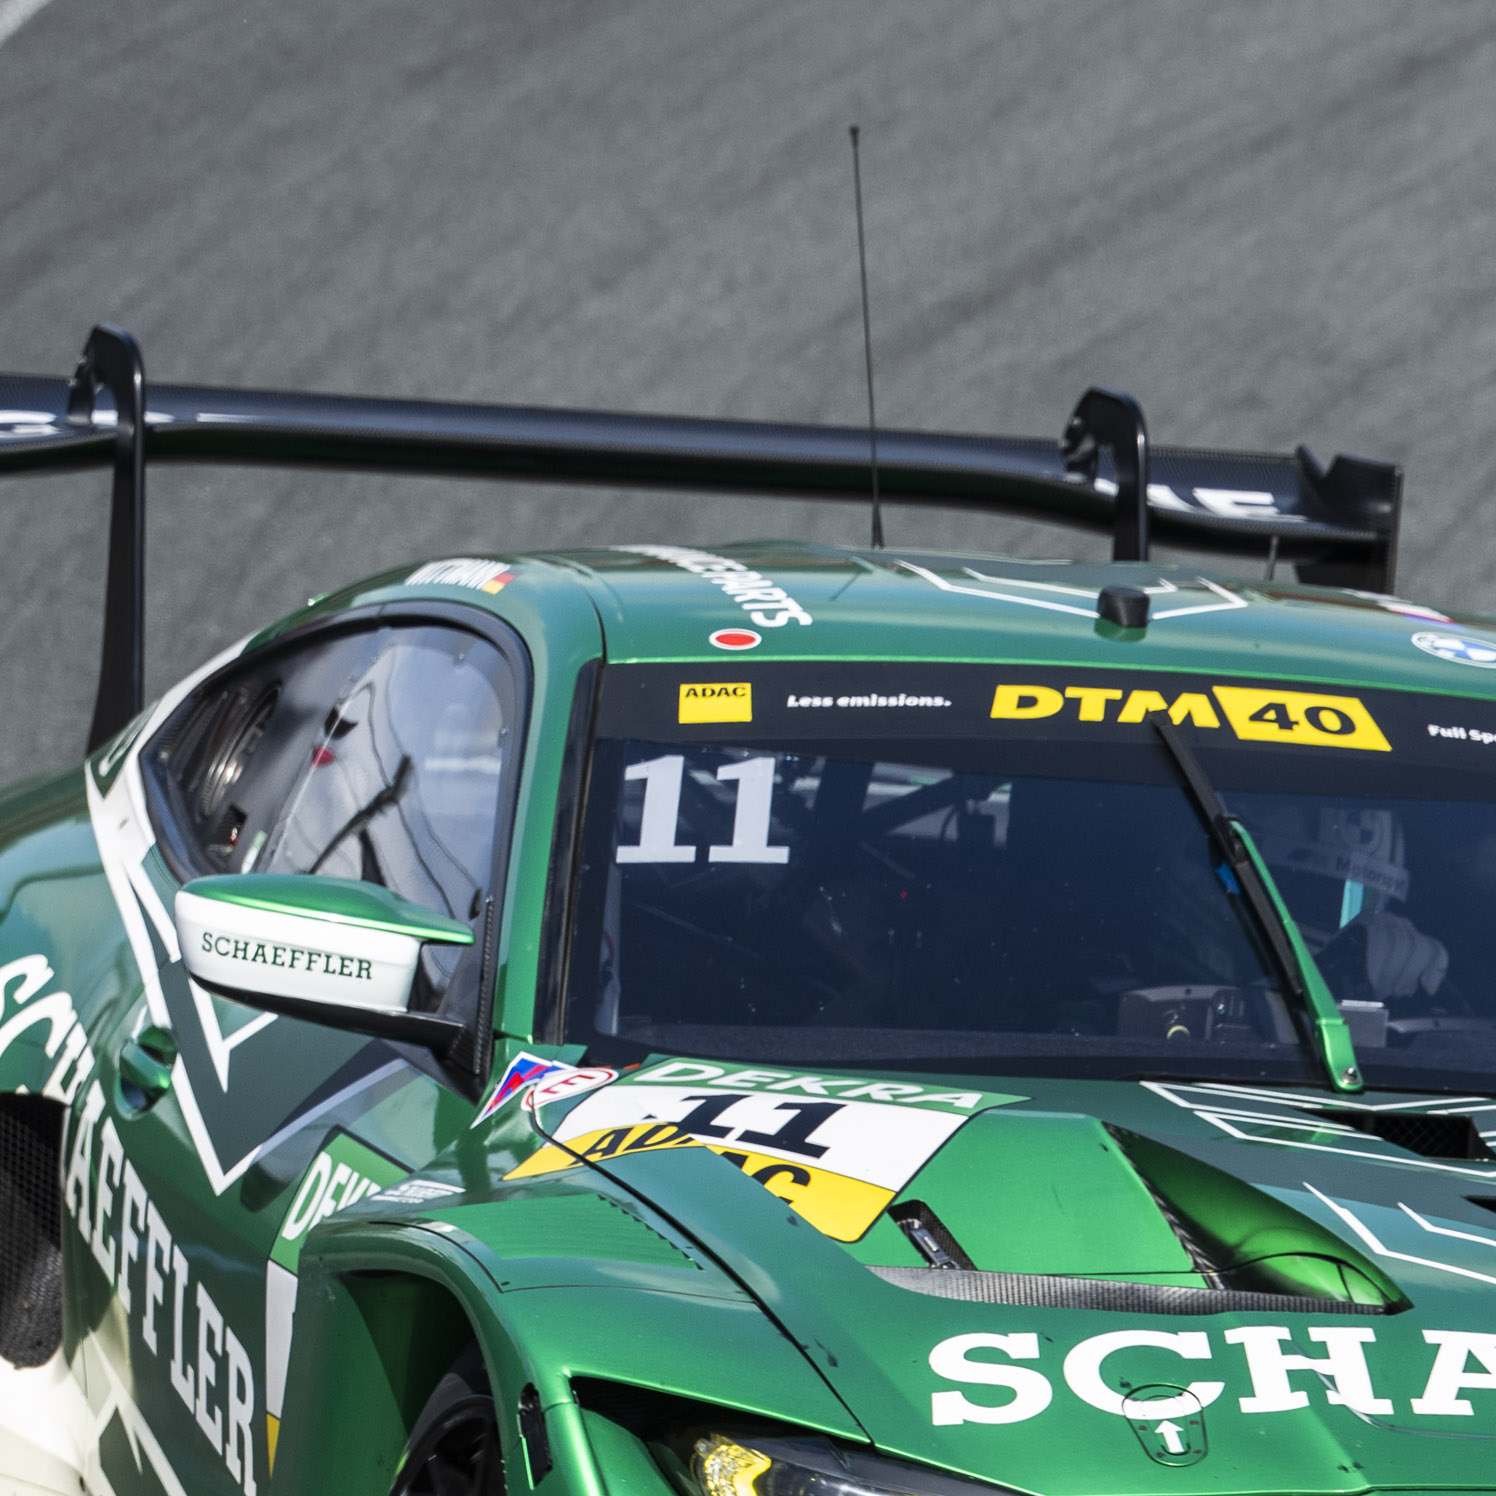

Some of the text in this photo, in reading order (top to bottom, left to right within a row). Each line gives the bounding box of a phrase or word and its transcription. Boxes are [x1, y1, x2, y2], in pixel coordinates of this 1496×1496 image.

[685, 687, 747, 699] ADAC
[787, 694, 952, 708] Less emissions.
[990, 685, 1356, 736] DTM 40
[1427, 724, 1466, 740] Full
[616, 754, 790, 864] 11
[201, 931, 373, 981] SCHAEFFLER
[633, 1062, 983, 1109] DEKRA
[641, 1093, 848, 1160] 11
